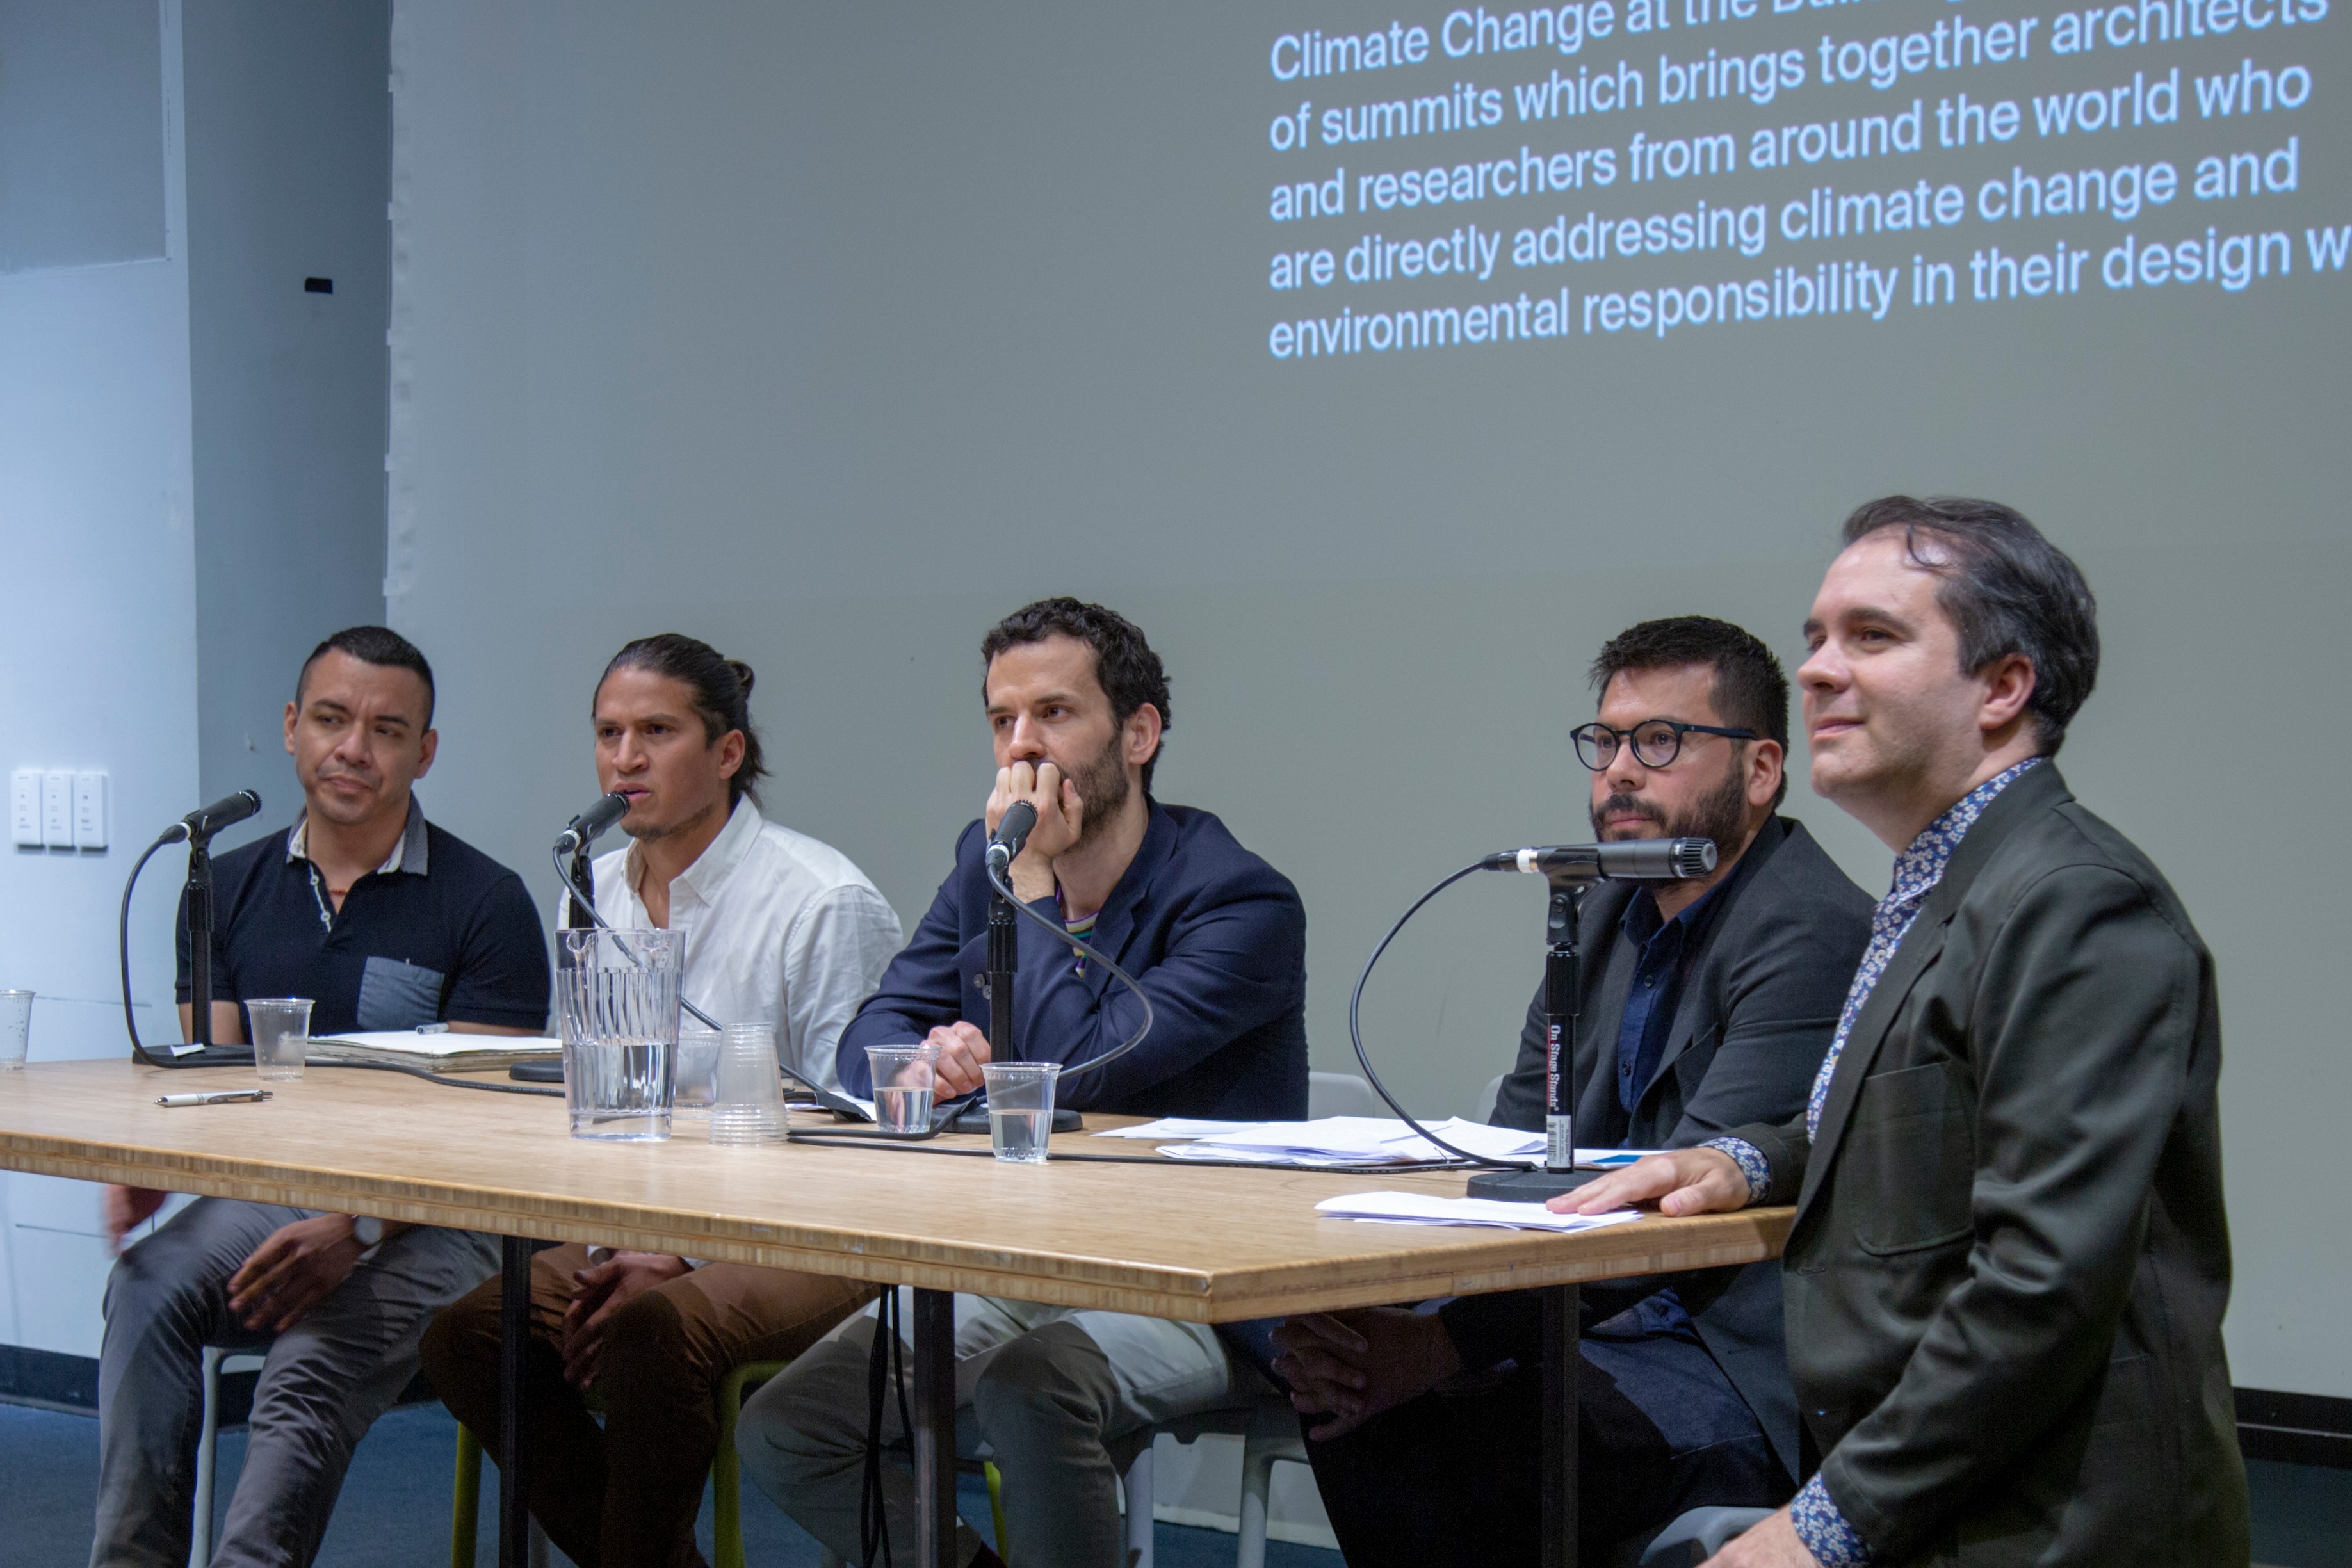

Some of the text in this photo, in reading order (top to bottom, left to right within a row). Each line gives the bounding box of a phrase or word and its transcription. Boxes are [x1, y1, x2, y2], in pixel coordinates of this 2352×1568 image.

[1270, 20, 1429, 81] Climate
[1441, 0, 1615, 58] Change
[1625, 0, 1671, 33] at
[1270, 0, 2329, 152] of summits which brings together architects
[1269, 59, 2312, 222] and researchers from around the world who
[1269, 137, 2299, 291] are directly addressing climate change and
[1269, 287, 1569, 359] environmental
[1584, 254, 1899, 339] responsibility
[1913, 254, 1955, 307] in
[1970, 241, 2090, 301] their
[2102, 225, 2291, 292] design
[1549, 1043, 1561, 1072] Stage
[1550, 1024, 1561, 1041] On
